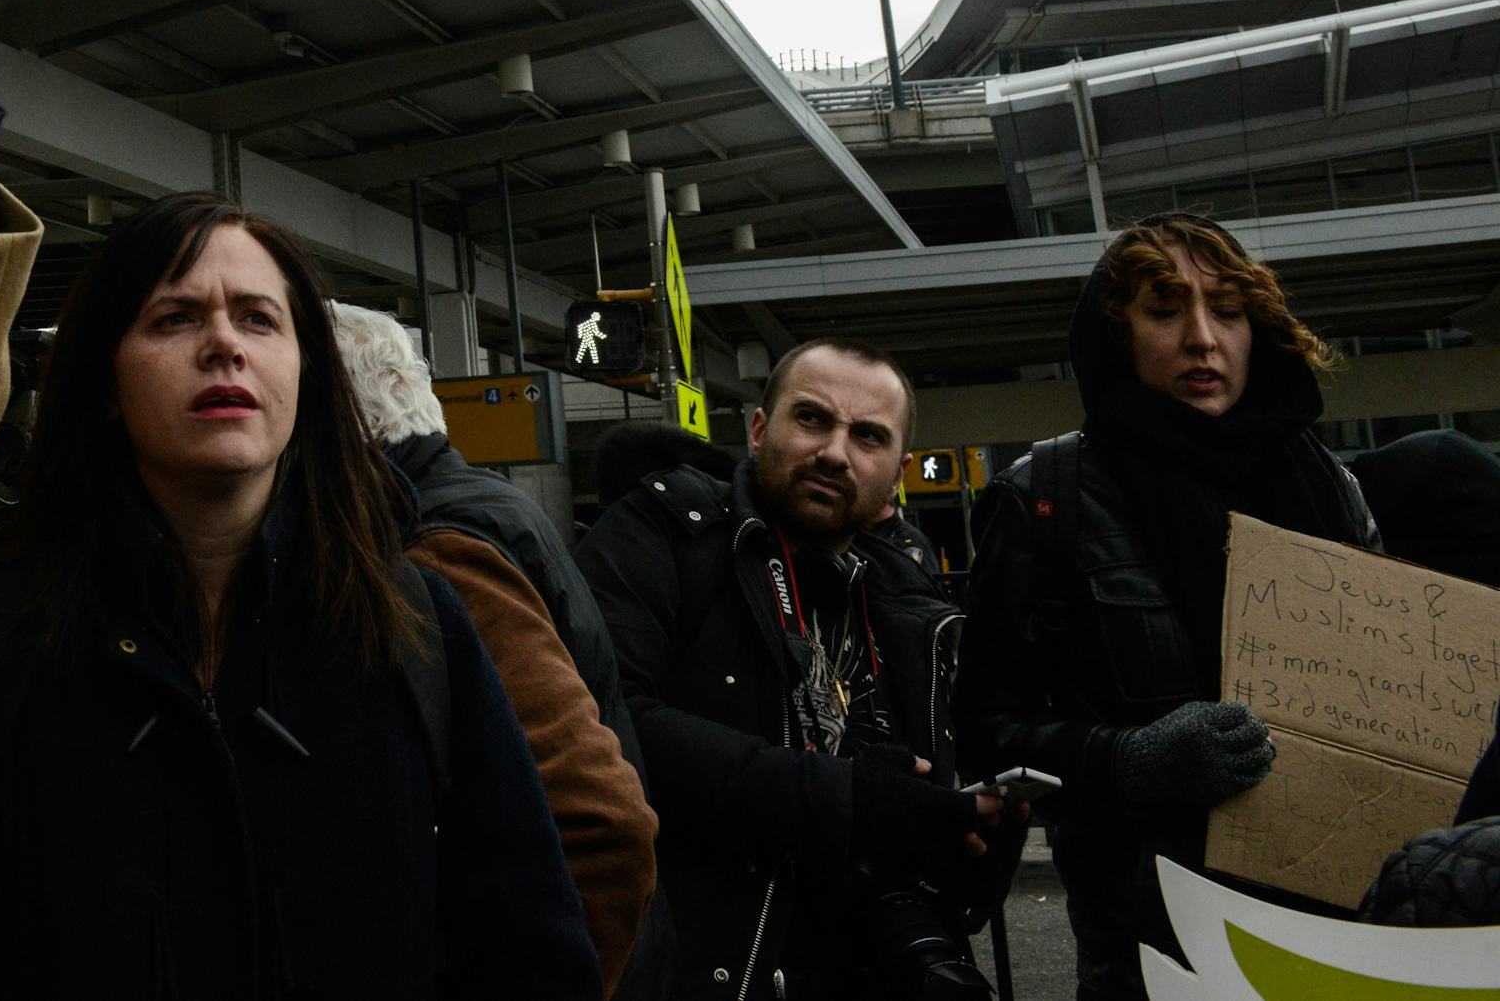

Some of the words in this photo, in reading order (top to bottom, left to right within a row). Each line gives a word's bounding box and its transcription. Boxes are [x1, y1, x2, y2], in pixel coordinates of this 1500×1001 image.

[768, 558, 793, 615] Canon
[1241, 579, 1414, 655] Muslims
[1290, 542, 1410, 614] Jews
[1423, 584, 1448, 621] &
